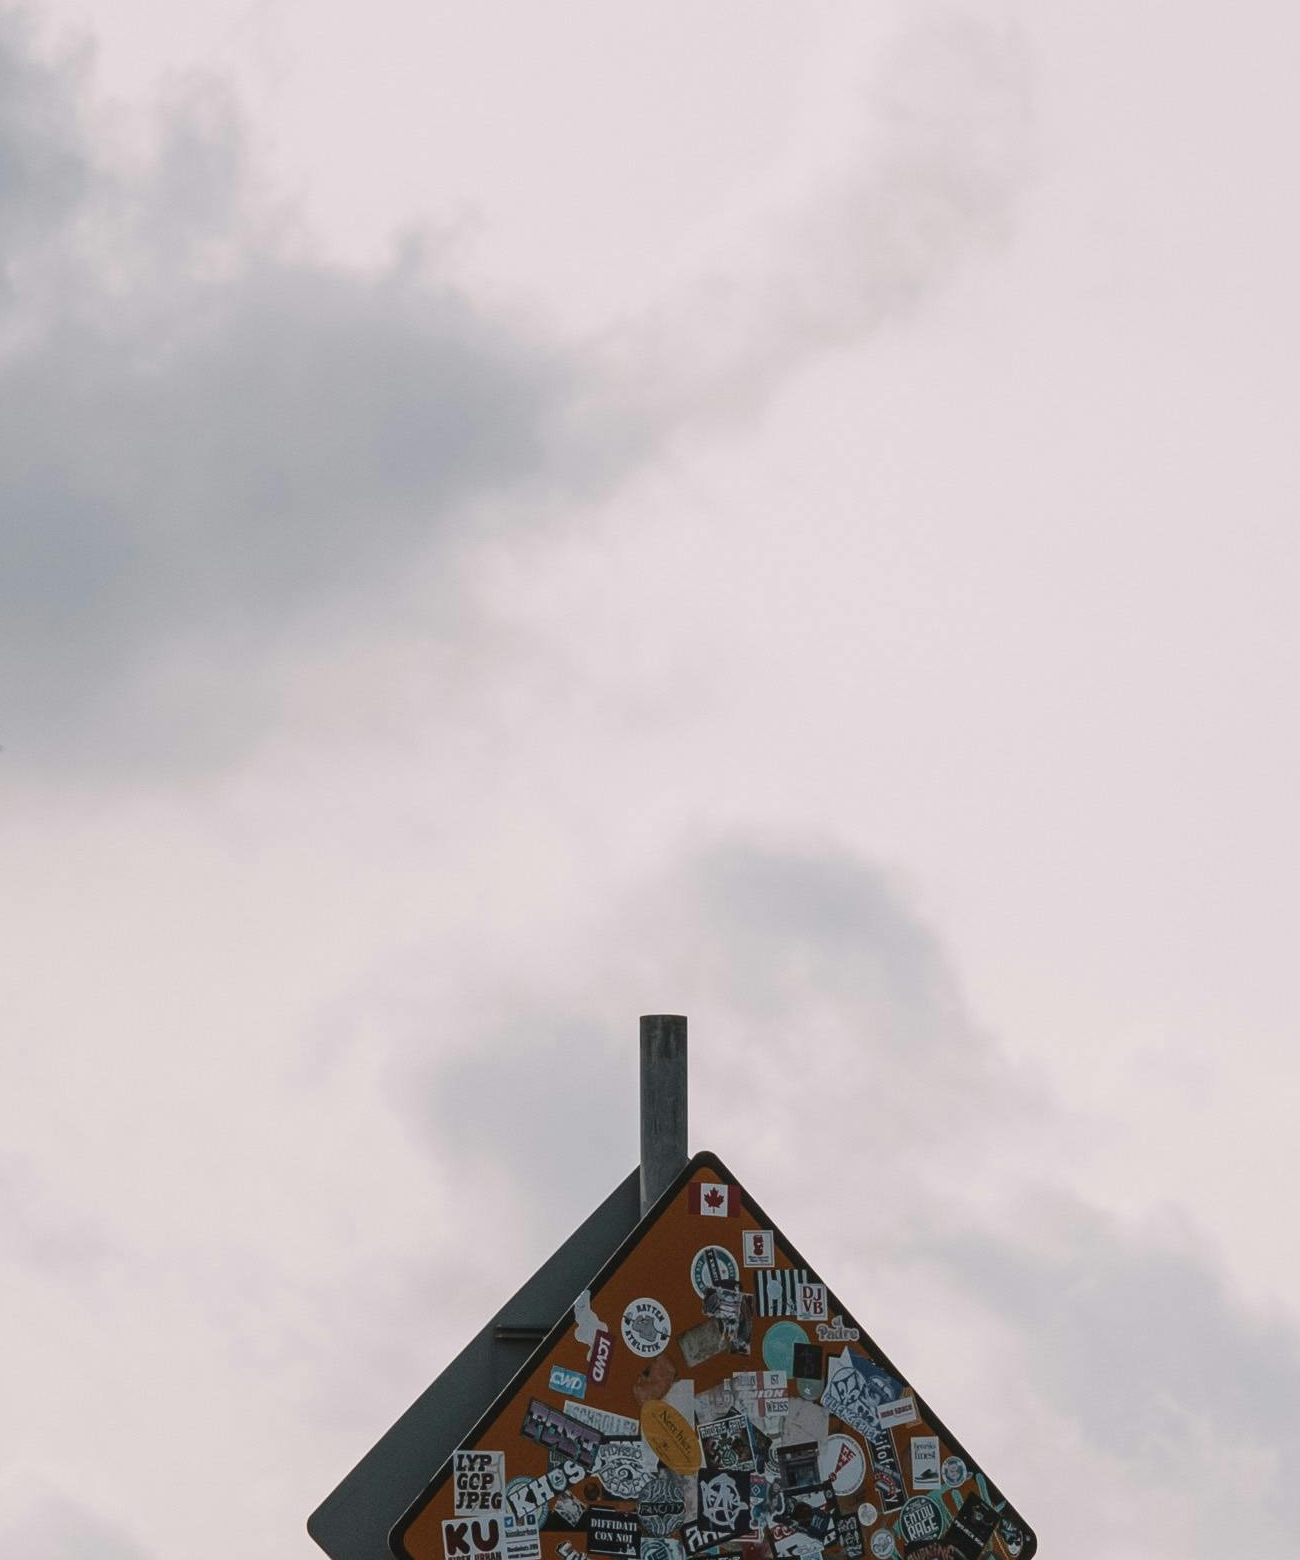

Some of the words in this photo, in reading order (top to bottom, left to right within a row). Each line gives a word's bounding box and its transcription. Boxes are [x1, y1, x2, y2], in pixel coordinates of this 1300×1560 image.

[803, 1286, 822, 1301] DJ
[636, 1304, 664, 1322] RATTEN
[803, 1299, 823, 1315] VB
[624, 1330, 661, 1352] ATHLETIK
[551, 1371, 583, 1390] CWD
[456, 1454, 492, 1472] LYP
[457, 1472, 494, 1491] GCP
[455, 1491, 503, 1510] JPEG
[591, 1518, 637, 1532] DIFFIDATI
[445, 1518, 500, 1556] KU
[595, 1531, 612, 1542] CON
[616, 1532, 633, 1543] NOI
